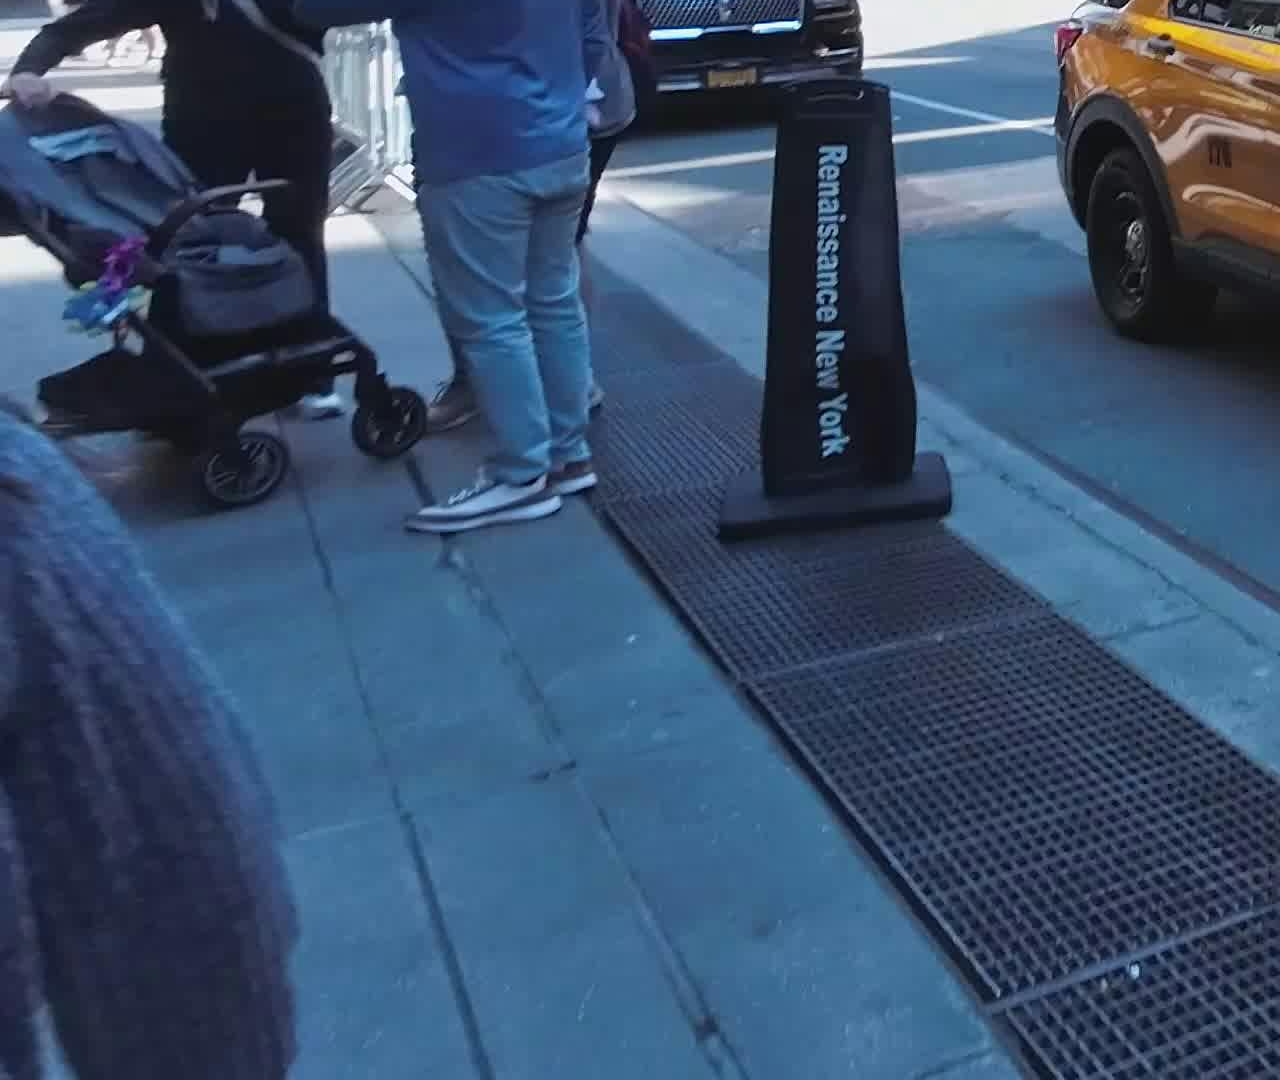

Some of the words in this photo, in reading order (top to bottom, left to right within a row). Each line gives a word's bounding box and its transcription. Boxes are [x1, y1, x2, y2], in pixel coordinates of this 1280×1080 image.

[816, 144, 848, 323] Renaissance
[816, 329, 846, 390] New
[818, 391, 851, 459] York
